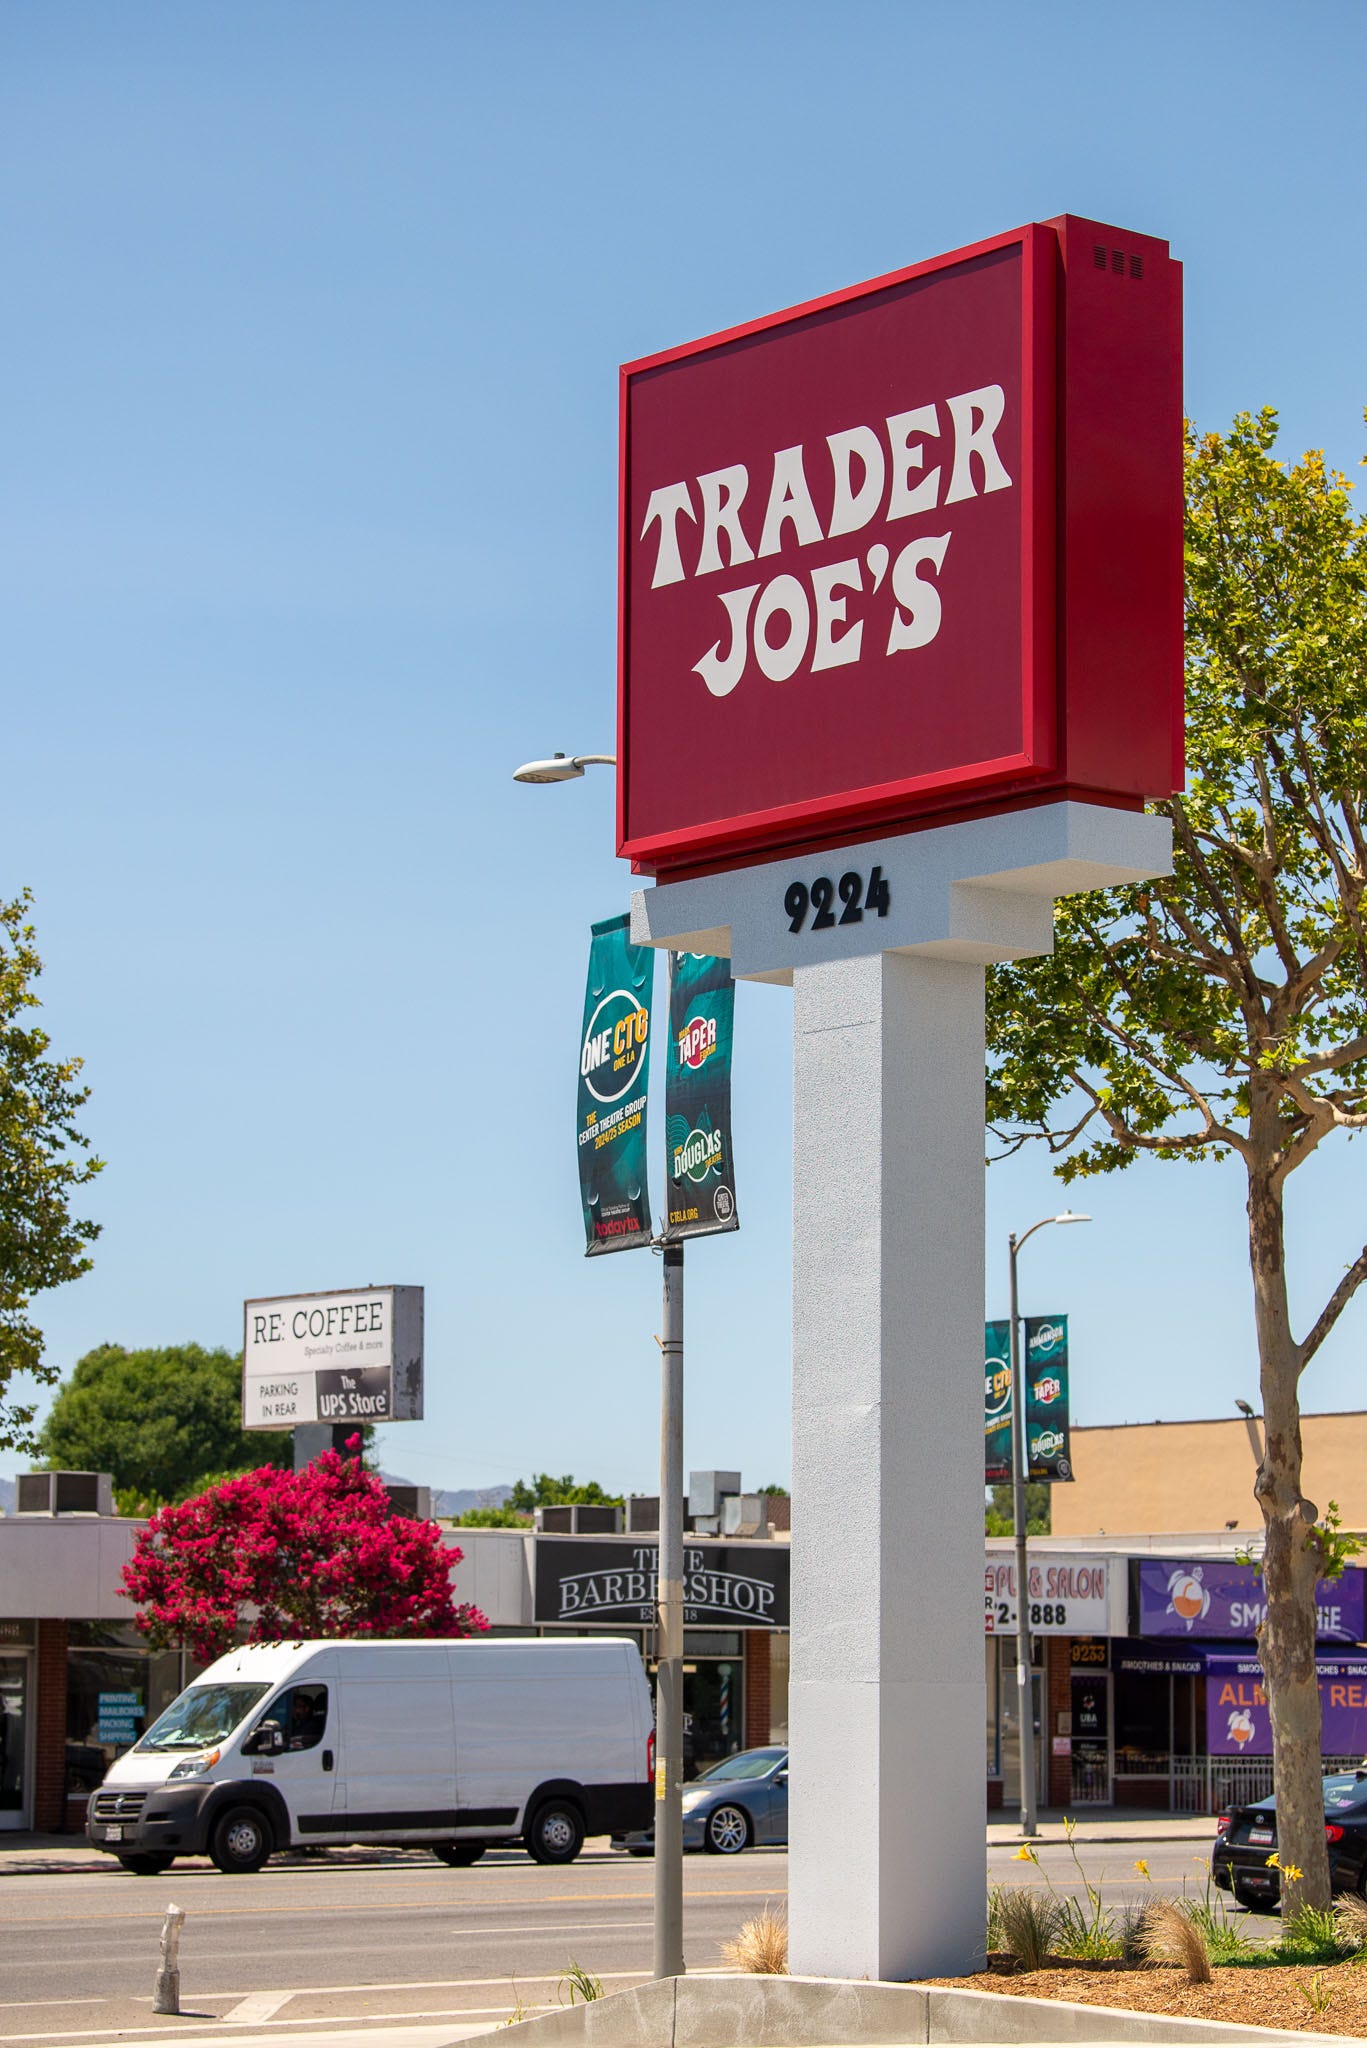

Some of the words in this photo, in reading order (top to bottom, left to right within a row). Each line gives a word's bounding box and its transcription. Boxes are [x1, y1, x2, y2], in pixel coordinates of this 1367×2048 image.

[640, 384, 1013, 590] TRADER
[691, 531, 953, 698] JOE'S
[784, 865, 890, 934] 9224
[581, 1027, 613, 1076] ONE
[613, 1007, 648, 1055] CTG
[679, 1018, 717, 1065] TAPER
[613, 1054, 627, 1072] ONE
[626, 1050, 636, 1064] LA
[578, 1123, 600, 1146] CENTER
[599, 1107, 625, 1132] THEATRE
[624, 1095, 647, 1117] GROUP
[586, 1110, 597, 1127] THE
[595, 1126, 617, 1150] 2024/25
[617, 1112, 641, 1136] SEASON
[674, 1129, 722, 1179] DOUGLAS
[253, 1314, 286, 1344] RE:
[292, 1301, 383, 1340] COFFEE
[304, 1345, 334, 1357] Specialty
[335, 1342, 357, 1353] Coffee
[359, 1342, 364, 1351] &
[365, 1341, 384, 1350] more
[260, 1382, 299, 1398] PARKING
[341, 1375, 357, 1390] The
[1034, 1379, 1060, 1402] TAPER
[262, 1405, 272, 1417] IN
[275, 1402, 297, 1416] REAR
[320, 1393, 346, 1416] UPS
[349, 1391, 387, 1414] Store
[1031, 1433, 1065, 1453] DOUGLAS
[633, 1549, 704, 1573] TE
[1029, 1567, 1043, 1598] &
[1046, 1567, 1104, 1600] SALON
[995, 1603, 1066, 1625] 2-888
[1121, 1660, 1163, 1671] SMOOTHIES
[1171, 1662, 1201, 1672] SNACKS
